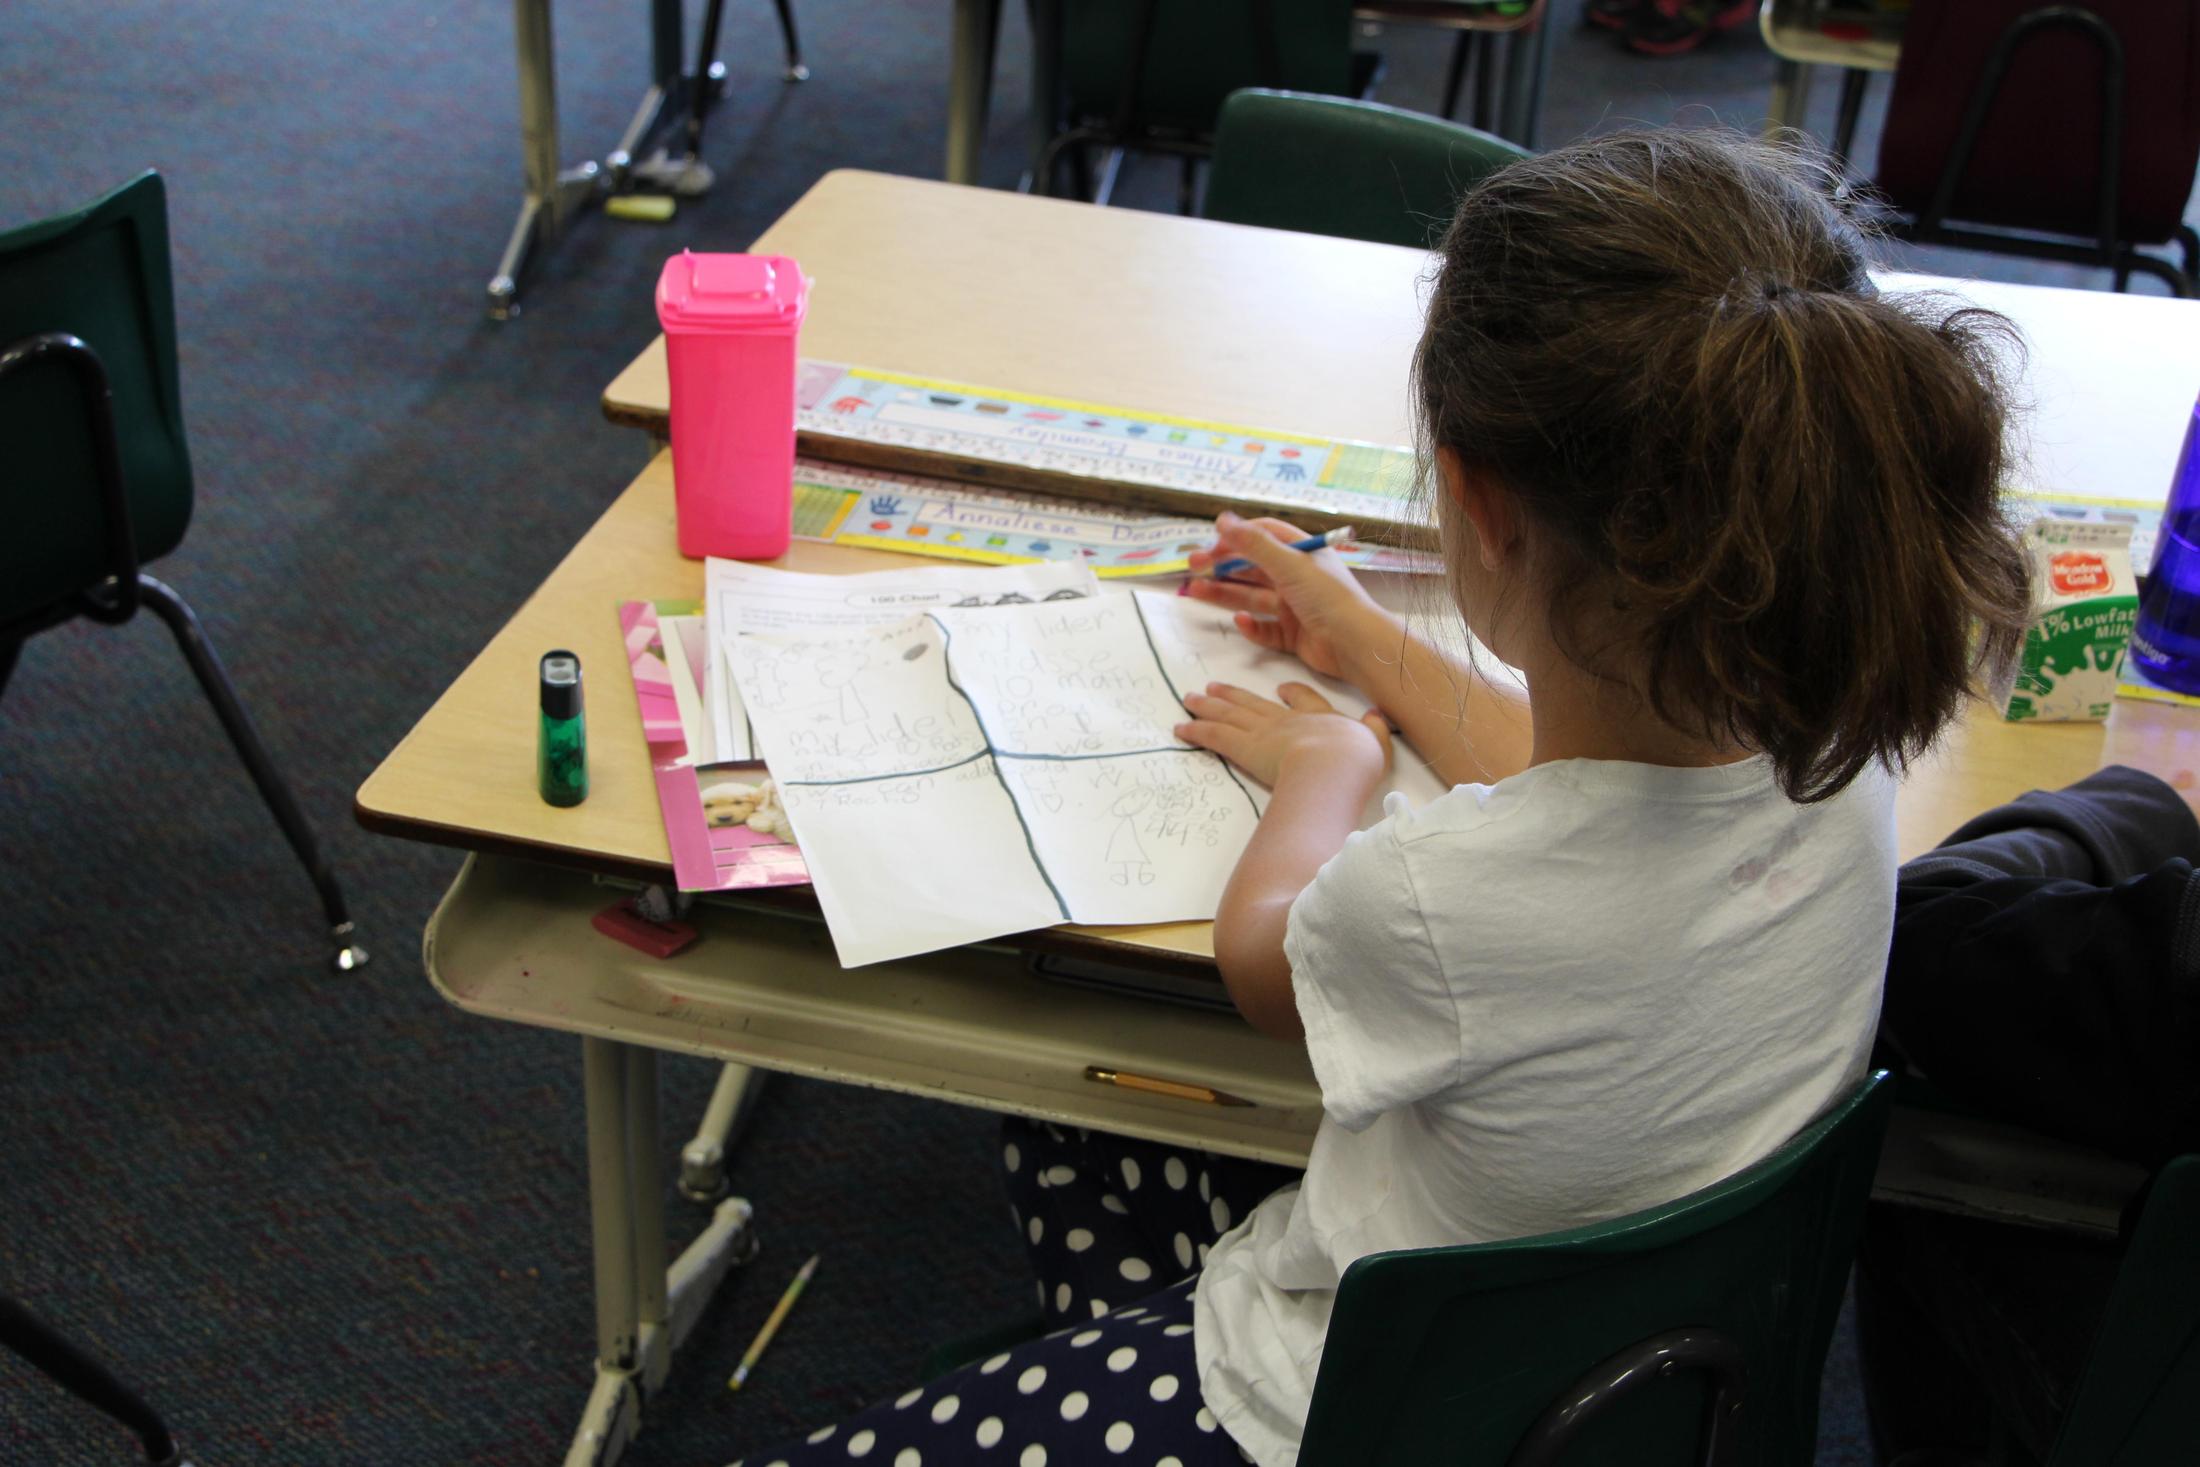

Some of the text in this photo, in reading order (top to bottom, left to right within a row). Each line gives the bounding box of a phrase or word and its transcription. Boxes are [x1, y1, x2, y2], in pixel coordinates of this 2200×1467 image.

[933, 503, 1079, 536] Annaliese
[2066, 572, 2097, 585] Gold
[899, 592, 941, 604] Chart
[2074, 607, 2136, 631] Lowfat
[2096, 625, 2130, 639] Milk
